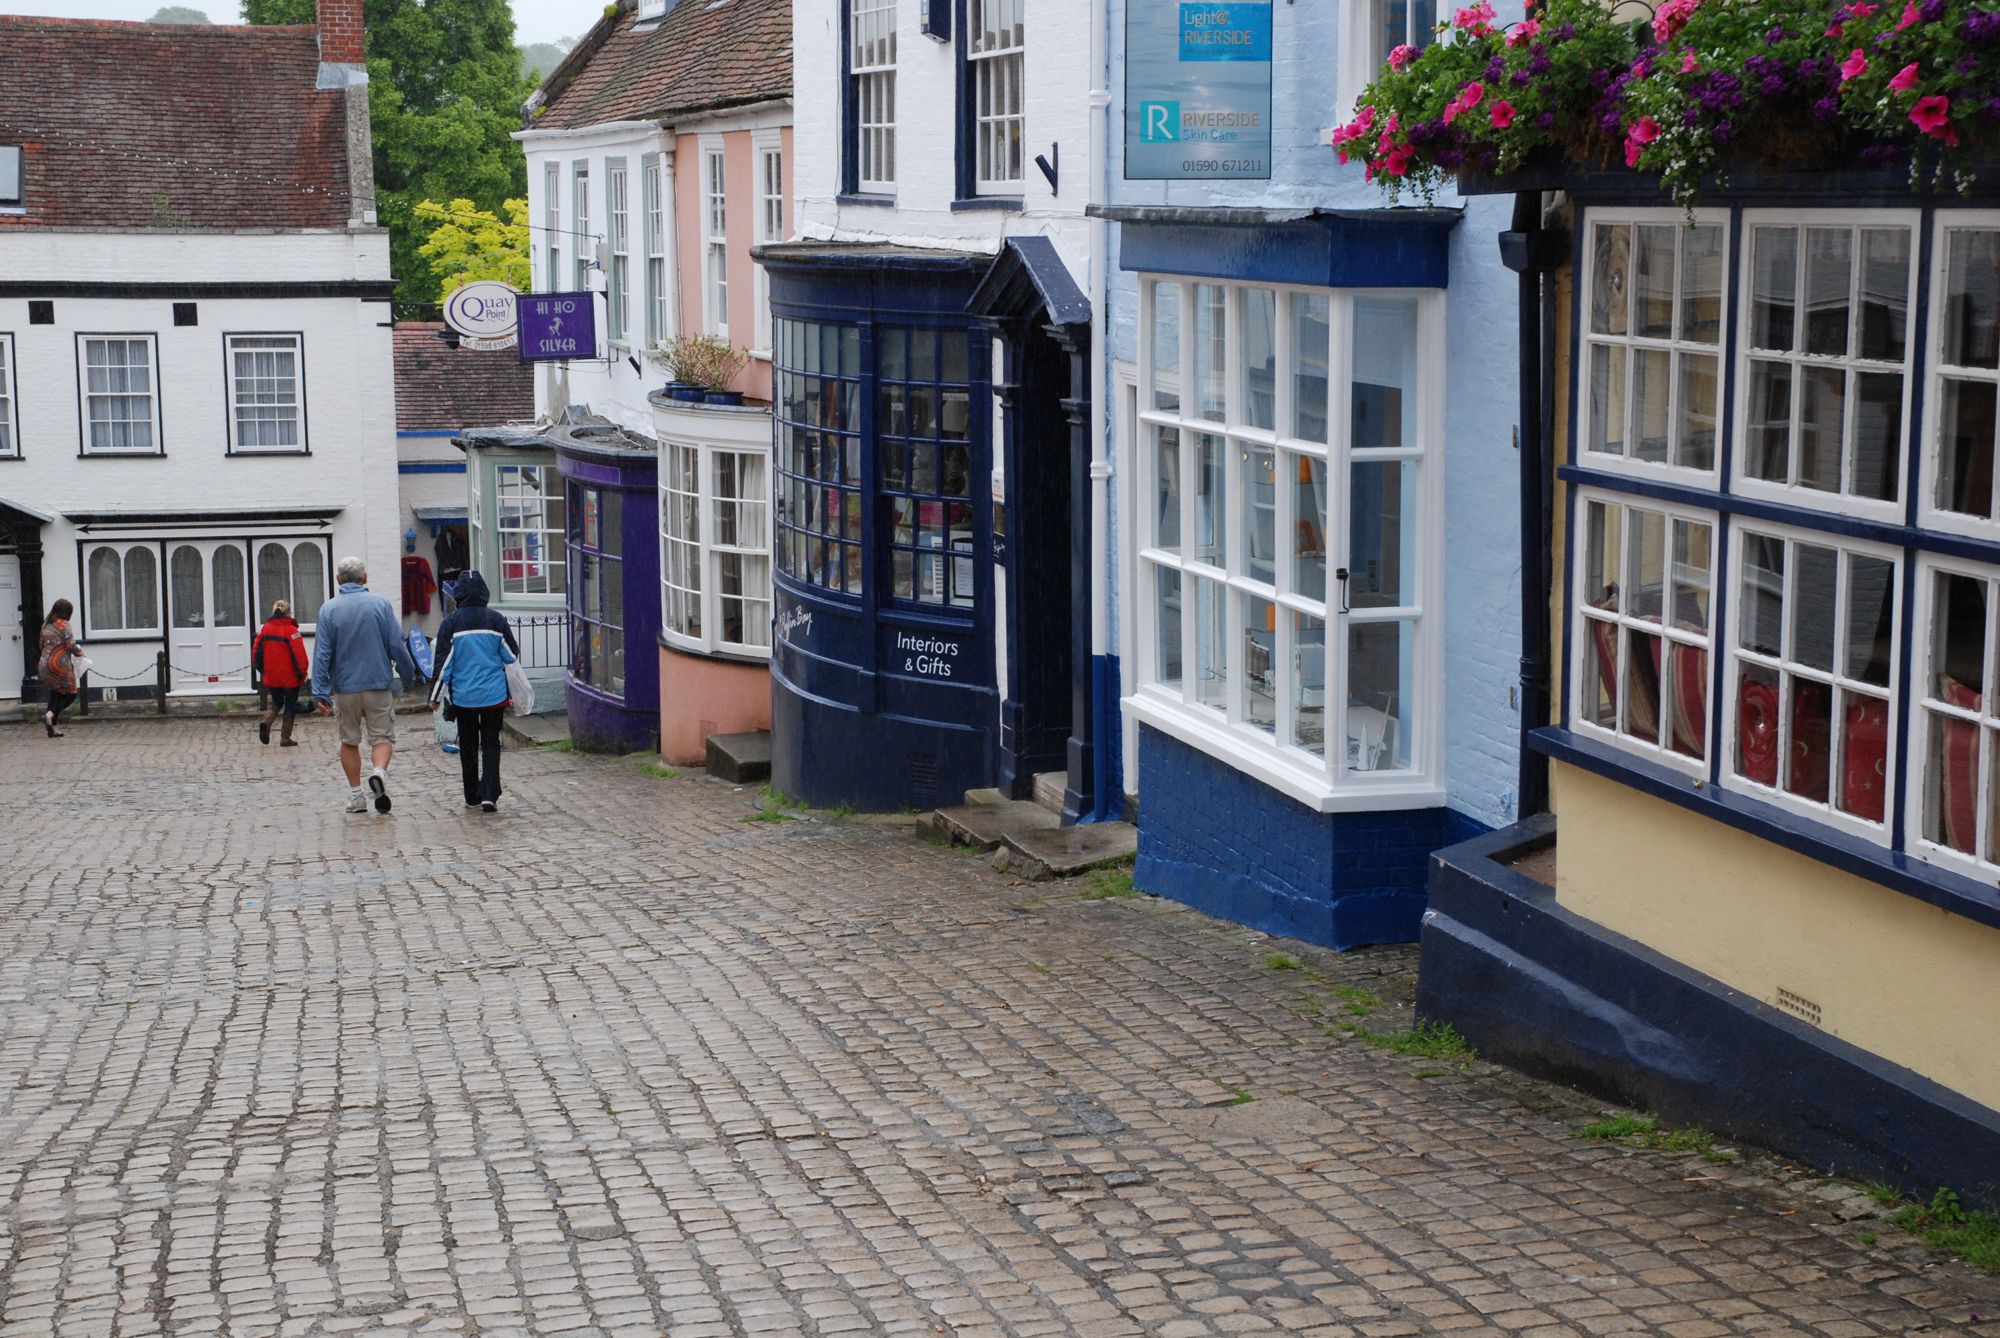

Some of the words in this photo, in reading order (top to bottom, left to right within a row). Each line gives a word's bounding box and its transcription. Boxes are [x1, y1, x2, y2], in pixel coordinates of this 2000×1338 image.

[1184, 30, 1253, 45] RIVERSIDE
[1148, 104, 1174, 140] R
[1183, 113, 1260, 127] RIVERSIDE
[1183, 129, 1207, 141] Skin
[1211, 129, 1237, 141] Care
[1182, 160, 1219, 172] 01590
[1221, 160, 1262, 172] 671211
[461, 296, 514, 322] Quay
[486, 309, 506, 319] Point
[536, 302, 548, 315] HI
[553, 300, 575, 314] HO
[539, 338, 576, 353] SILVER
[897, 632, 958, 656] Interiors
[905, 657, 913, 672] &
[916, 655, 951, 676] Gifts
